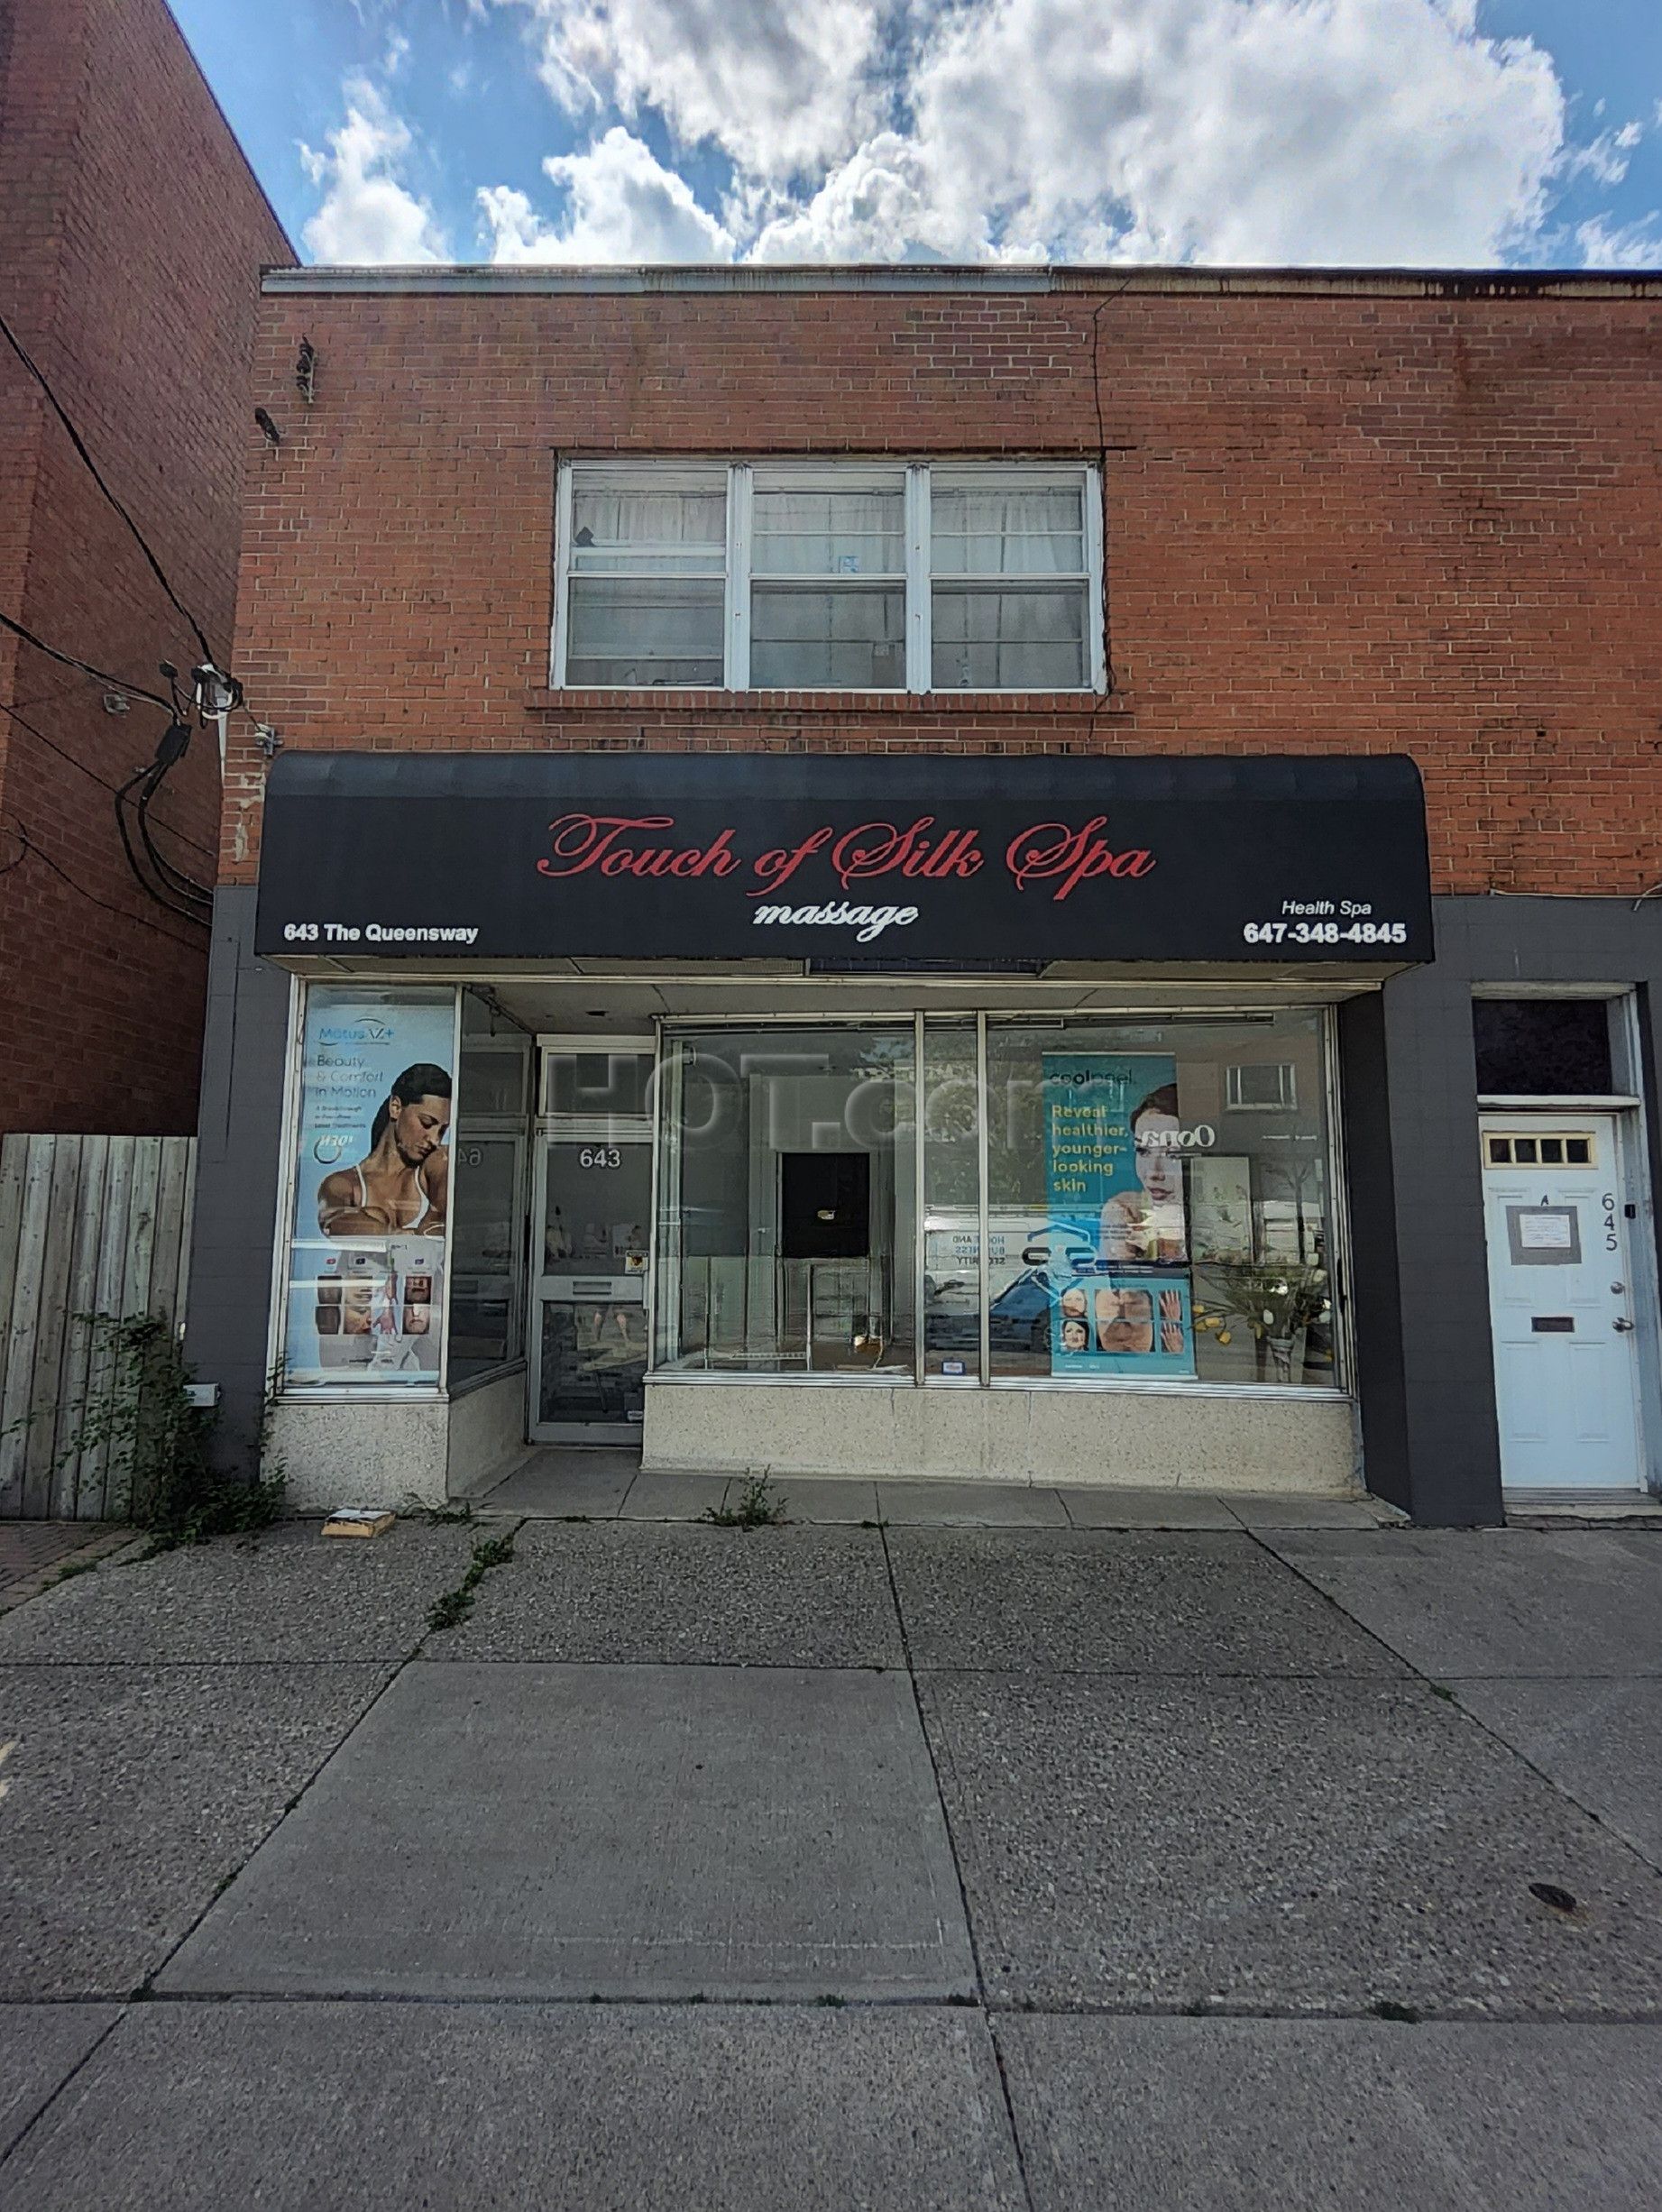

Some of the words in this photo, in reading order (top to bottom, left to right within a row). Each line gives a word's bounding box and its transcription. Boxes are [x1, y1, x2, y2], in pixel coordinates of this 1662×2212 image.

[536, 813, 740, 878] Touch
[746, 826, 833, 897] of
[831, 816, 985, 891] Silk
[1005, 815, 1157, 900] Spa
[1281, 900, 1336, 916] Health
[1339, 900, 1372, 919] Spa
[752, 902, 919, 943] massage
[283, 923, 319, 941] 643
[324, 923, 361, 941] The
[365, 923, 479, 945] Queensway
[1243, 922, 1407, 944] 647-348-4845
[317, 1054, 365, 1069] Beauty
[331, 1085, 377, 1098] Motion
[1051, 1104, 1107, 1119] Reveal
[1051, 1122, 1128, 1138] healthier,
[579, 1148, 621, 1169] 643
[1051, 1143, 1127, 1159] younger-
[1052, 1160, 1114, 1176] looking
[1053, 1178, 1087, 1192] skin
[1601, 1192, 1619, 1252] 645
